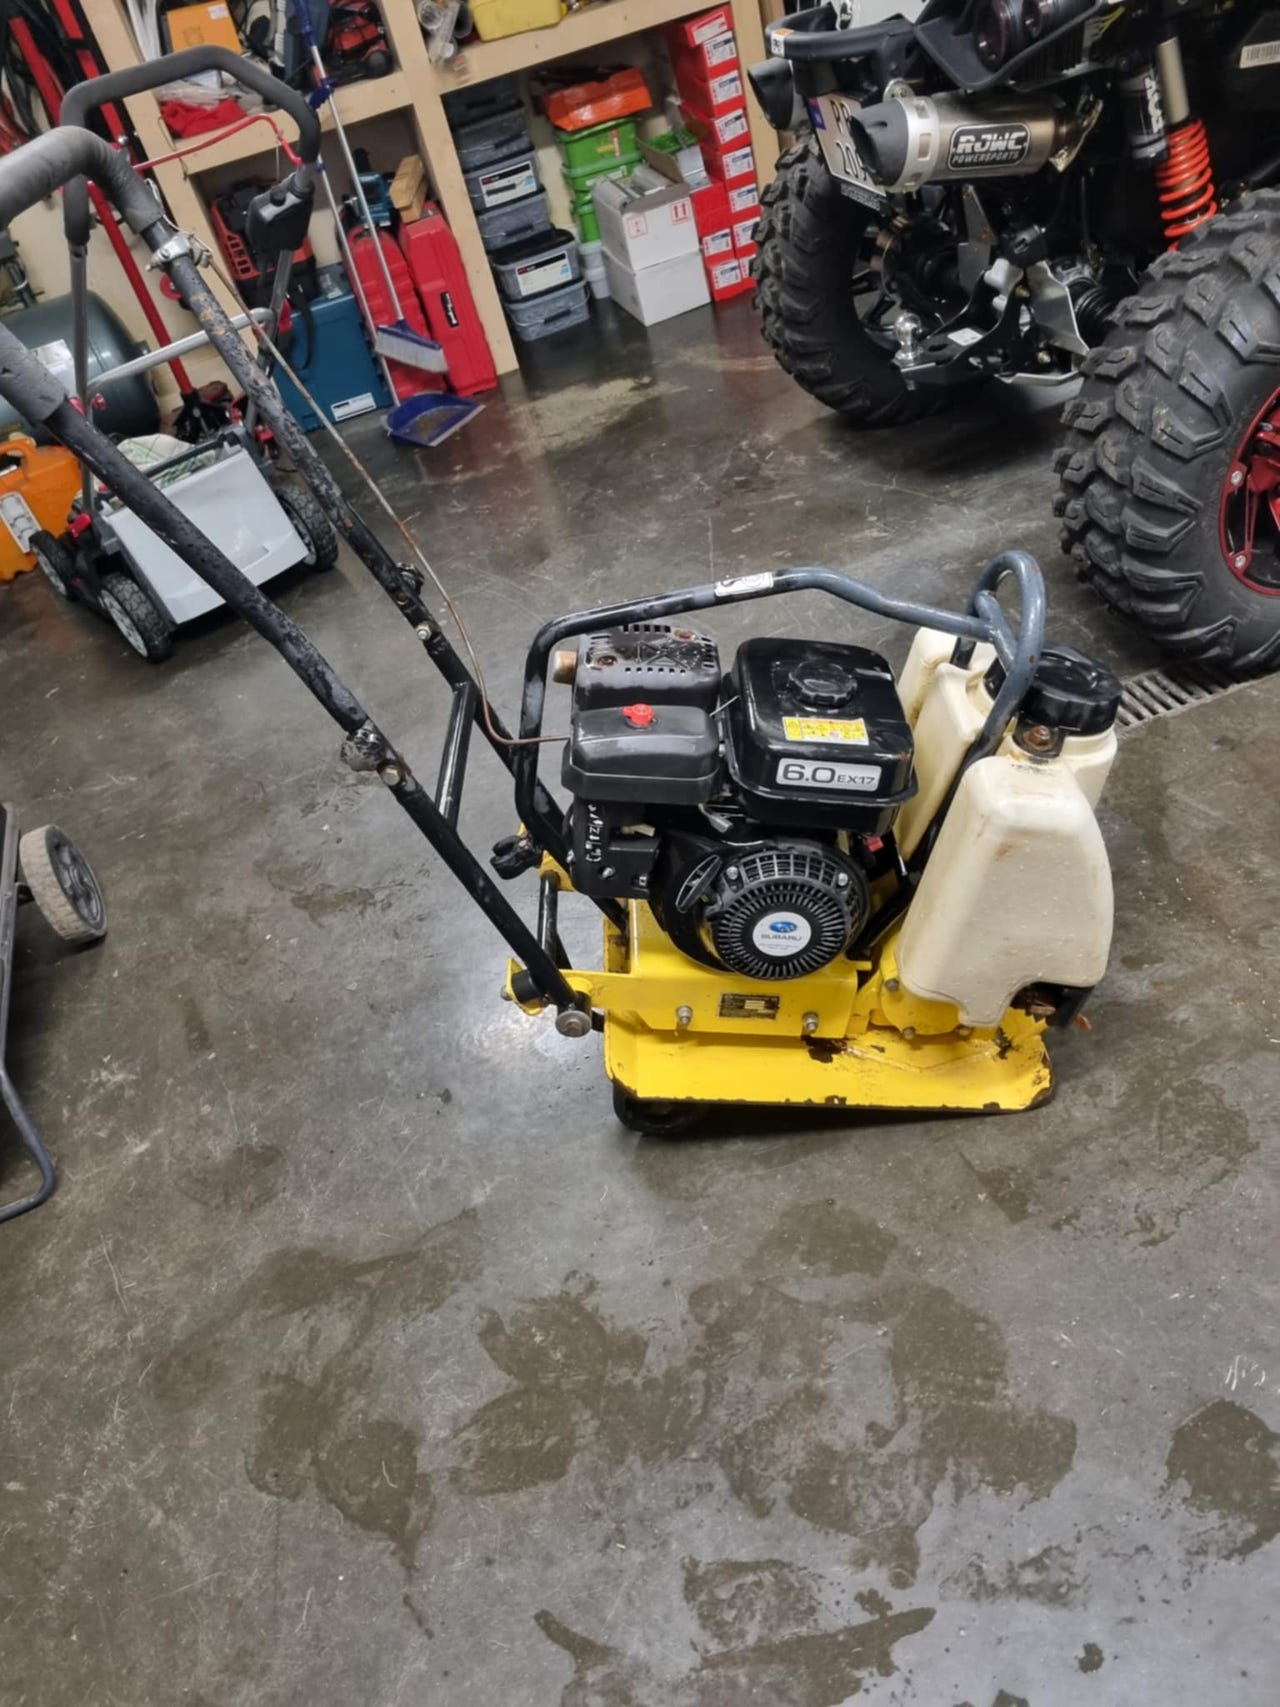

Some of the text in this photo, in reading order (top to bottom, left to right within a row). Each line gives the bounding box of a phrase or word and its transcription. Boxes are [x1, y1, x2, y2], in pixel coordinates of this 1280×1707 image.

[956, 131, 1026, 154] RJWC
[951, 151, 1020, 164] POWERSPORTS
[782, 763, 876, 786] 6.0 EX17
